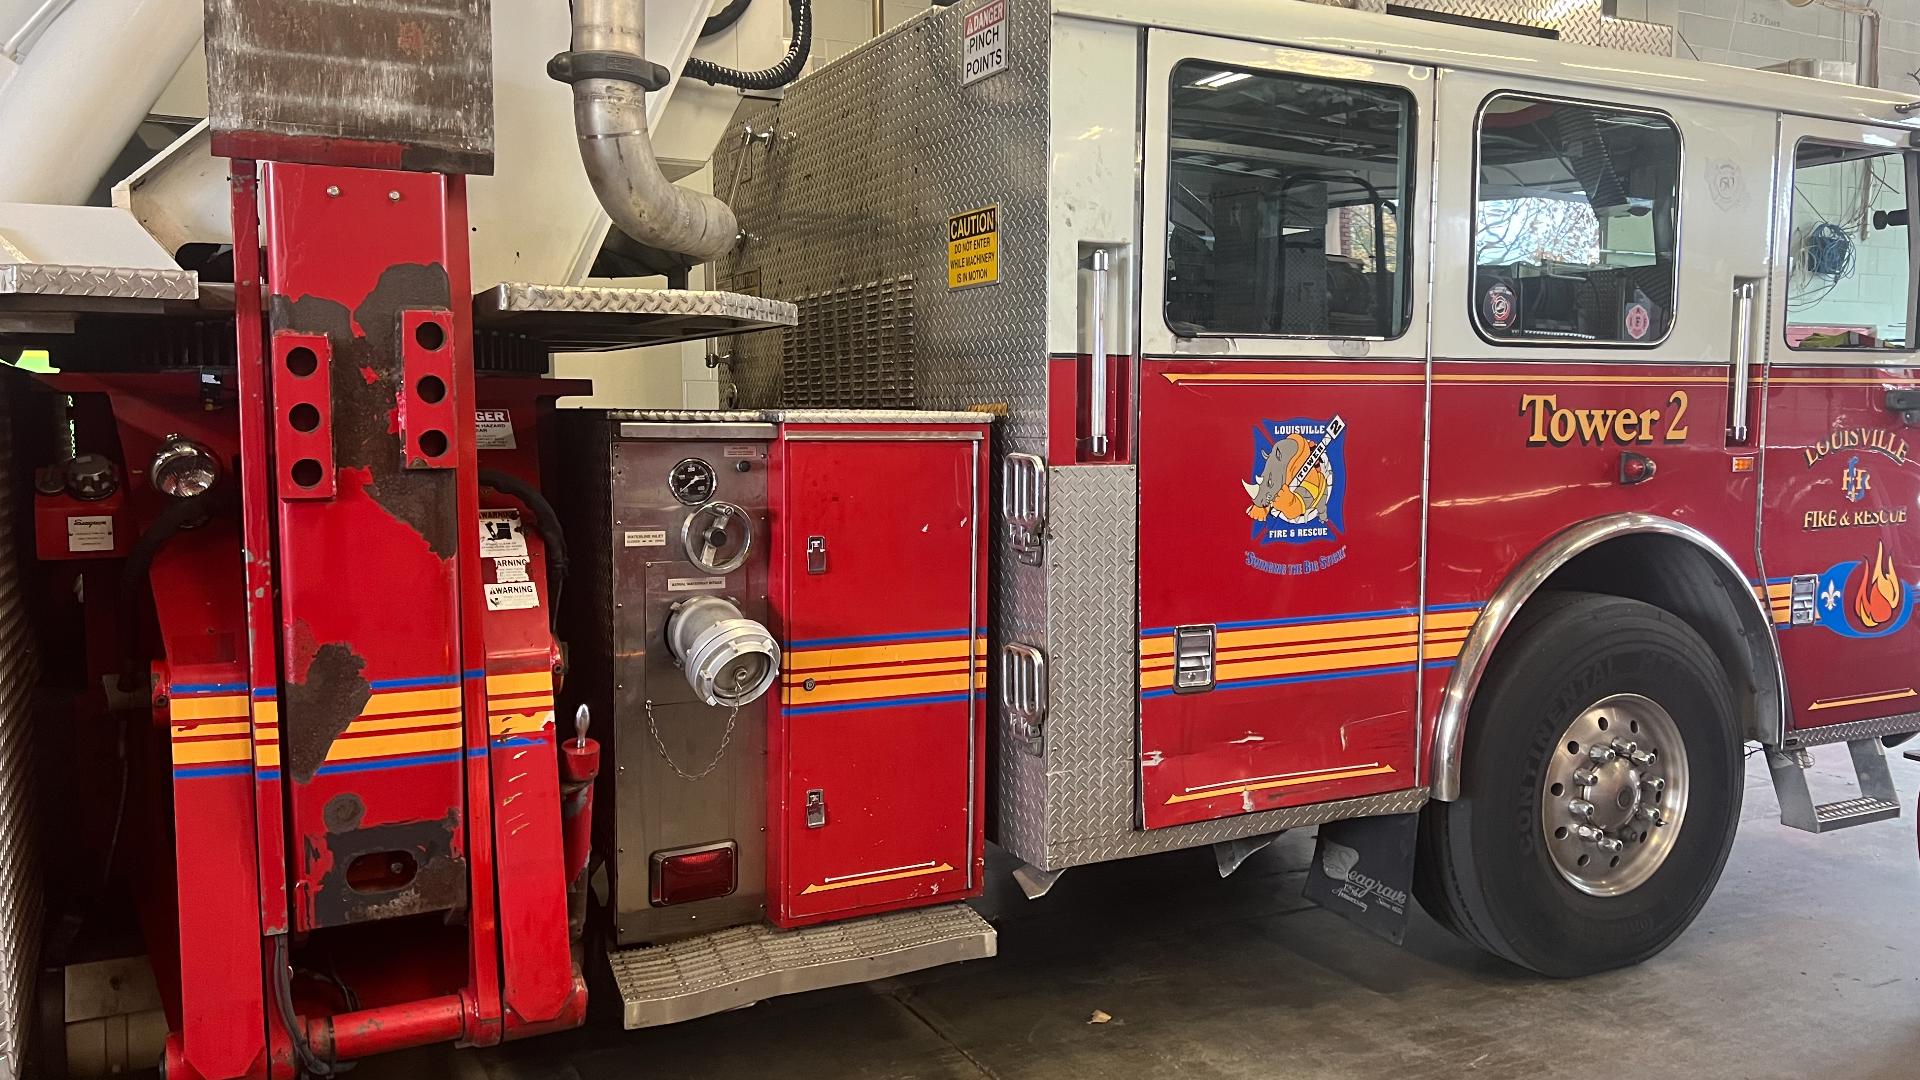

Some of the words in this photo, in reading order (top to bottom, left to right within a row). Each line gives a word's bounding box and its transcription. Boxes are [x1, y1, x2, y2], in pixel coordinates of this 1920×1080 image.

[973, 1, 1004, 32] DANGER
[969, 25, 999, 54] PINCH
[966, 48, 1002, 79] POINTS
[950, 210, 994, 240] CAUTION
[954, 243, 961, 254] DO
[962, 240, 972, 252] NOT
[973, 237, 991, 250] ENTER
[950, 257, 965, 270] WHILE
[966, 251, 995, 267] MACHINERY
[956, 273, 962, 283] IS
[962, 271, 968, 281] IN
[968, 268, 988, 280] MOTION
[475, 411, 505, 421] GER
[1520, 393, 1661, 446] Tower
[1664, 390, 1688, 443] 2
[1274, 425, 1326, 435] LOUISVILLE
[1298, 443, 1324, 480] TOWER
[1330, 418, 1343, 435] 2
[1804, 428, 1909, 468] LOUISVILLE
[1803, 509, 1838, 528] FIRE
[1839, 511, 1851, 526] &
[1854, 509, 1907, 526] RESCUE
[1269, 529, 1288, 539] FIRE
[1297, 527, 1328, 537] RESCUE
[496, 559, 528, 567] ARNING
[496, 585, 533, 595] WARNING
